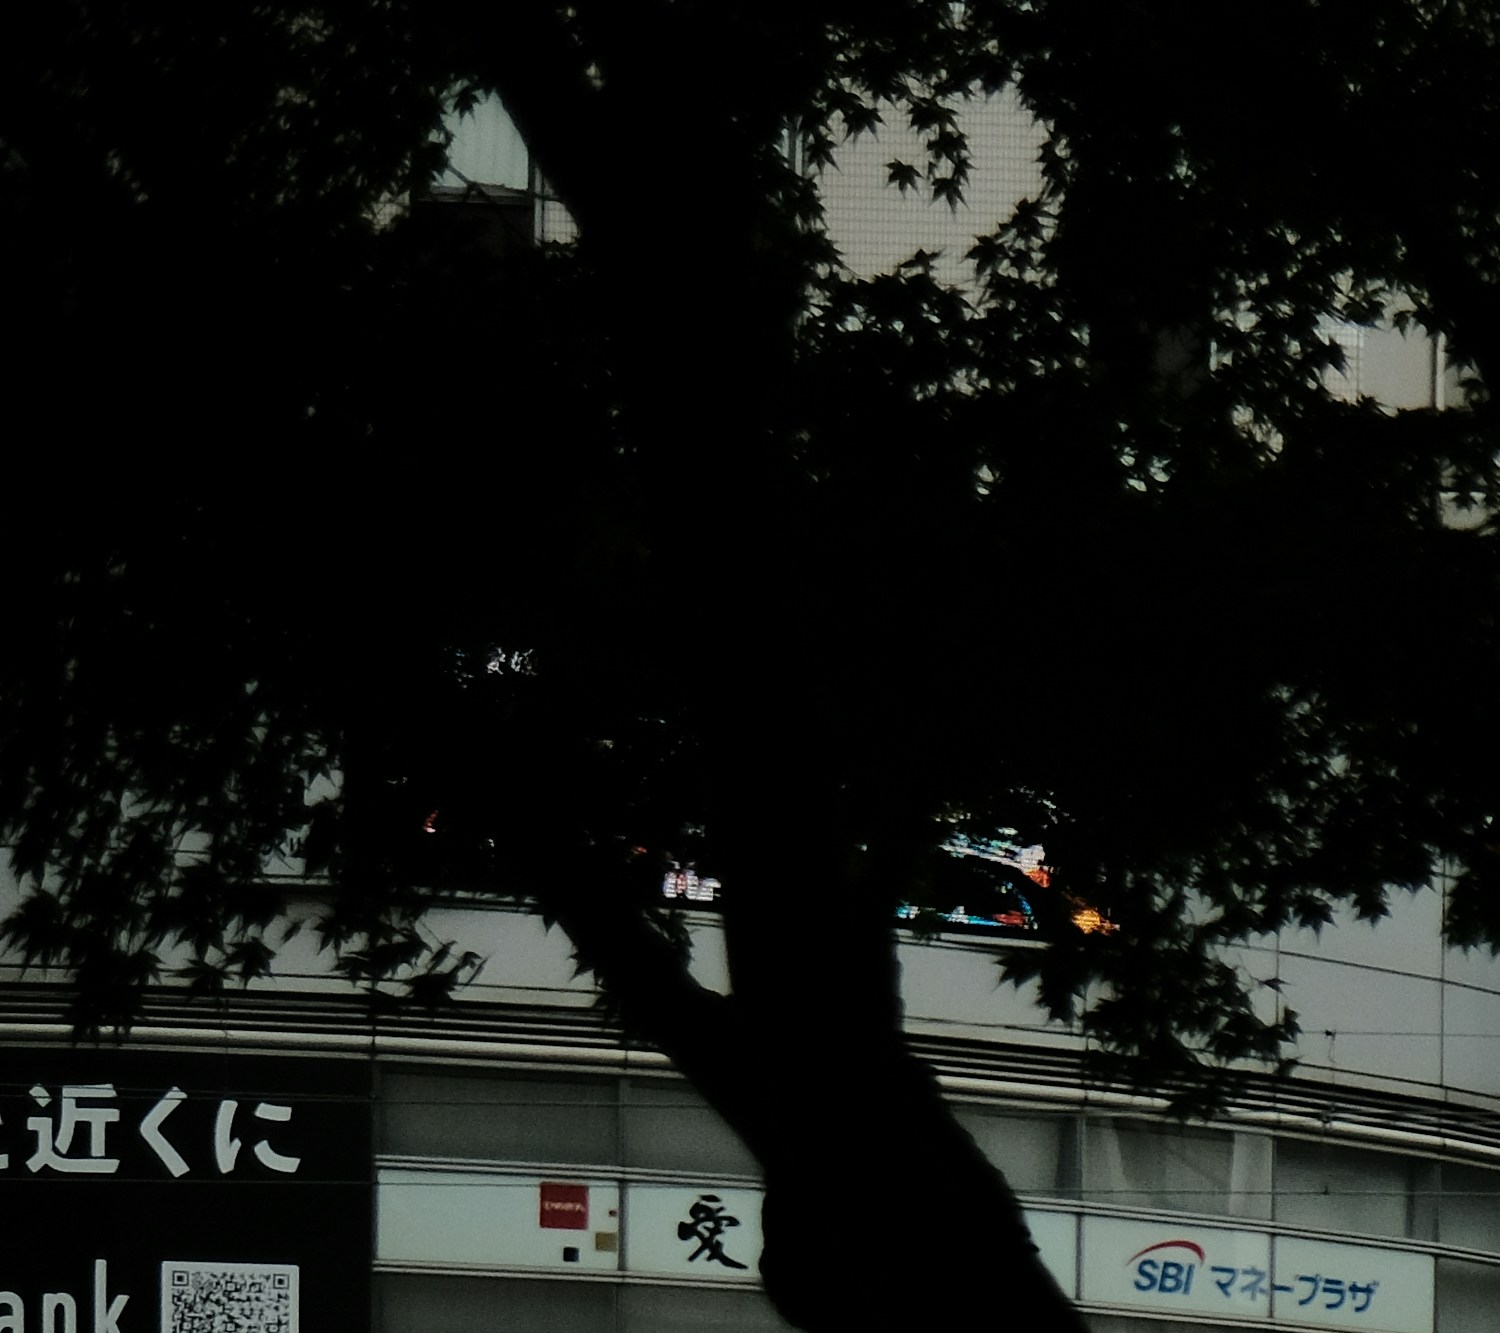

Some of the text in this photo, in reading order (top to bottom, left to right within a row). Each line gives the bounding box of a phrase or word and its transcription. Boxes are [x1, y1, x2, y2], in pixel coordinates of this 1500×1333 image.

[0, 1083, 301, 1178] 近くに
[677, 1194, 748, 1269] 愛
[1133, 1259, 1380, 1313] SBI マネープラザ
